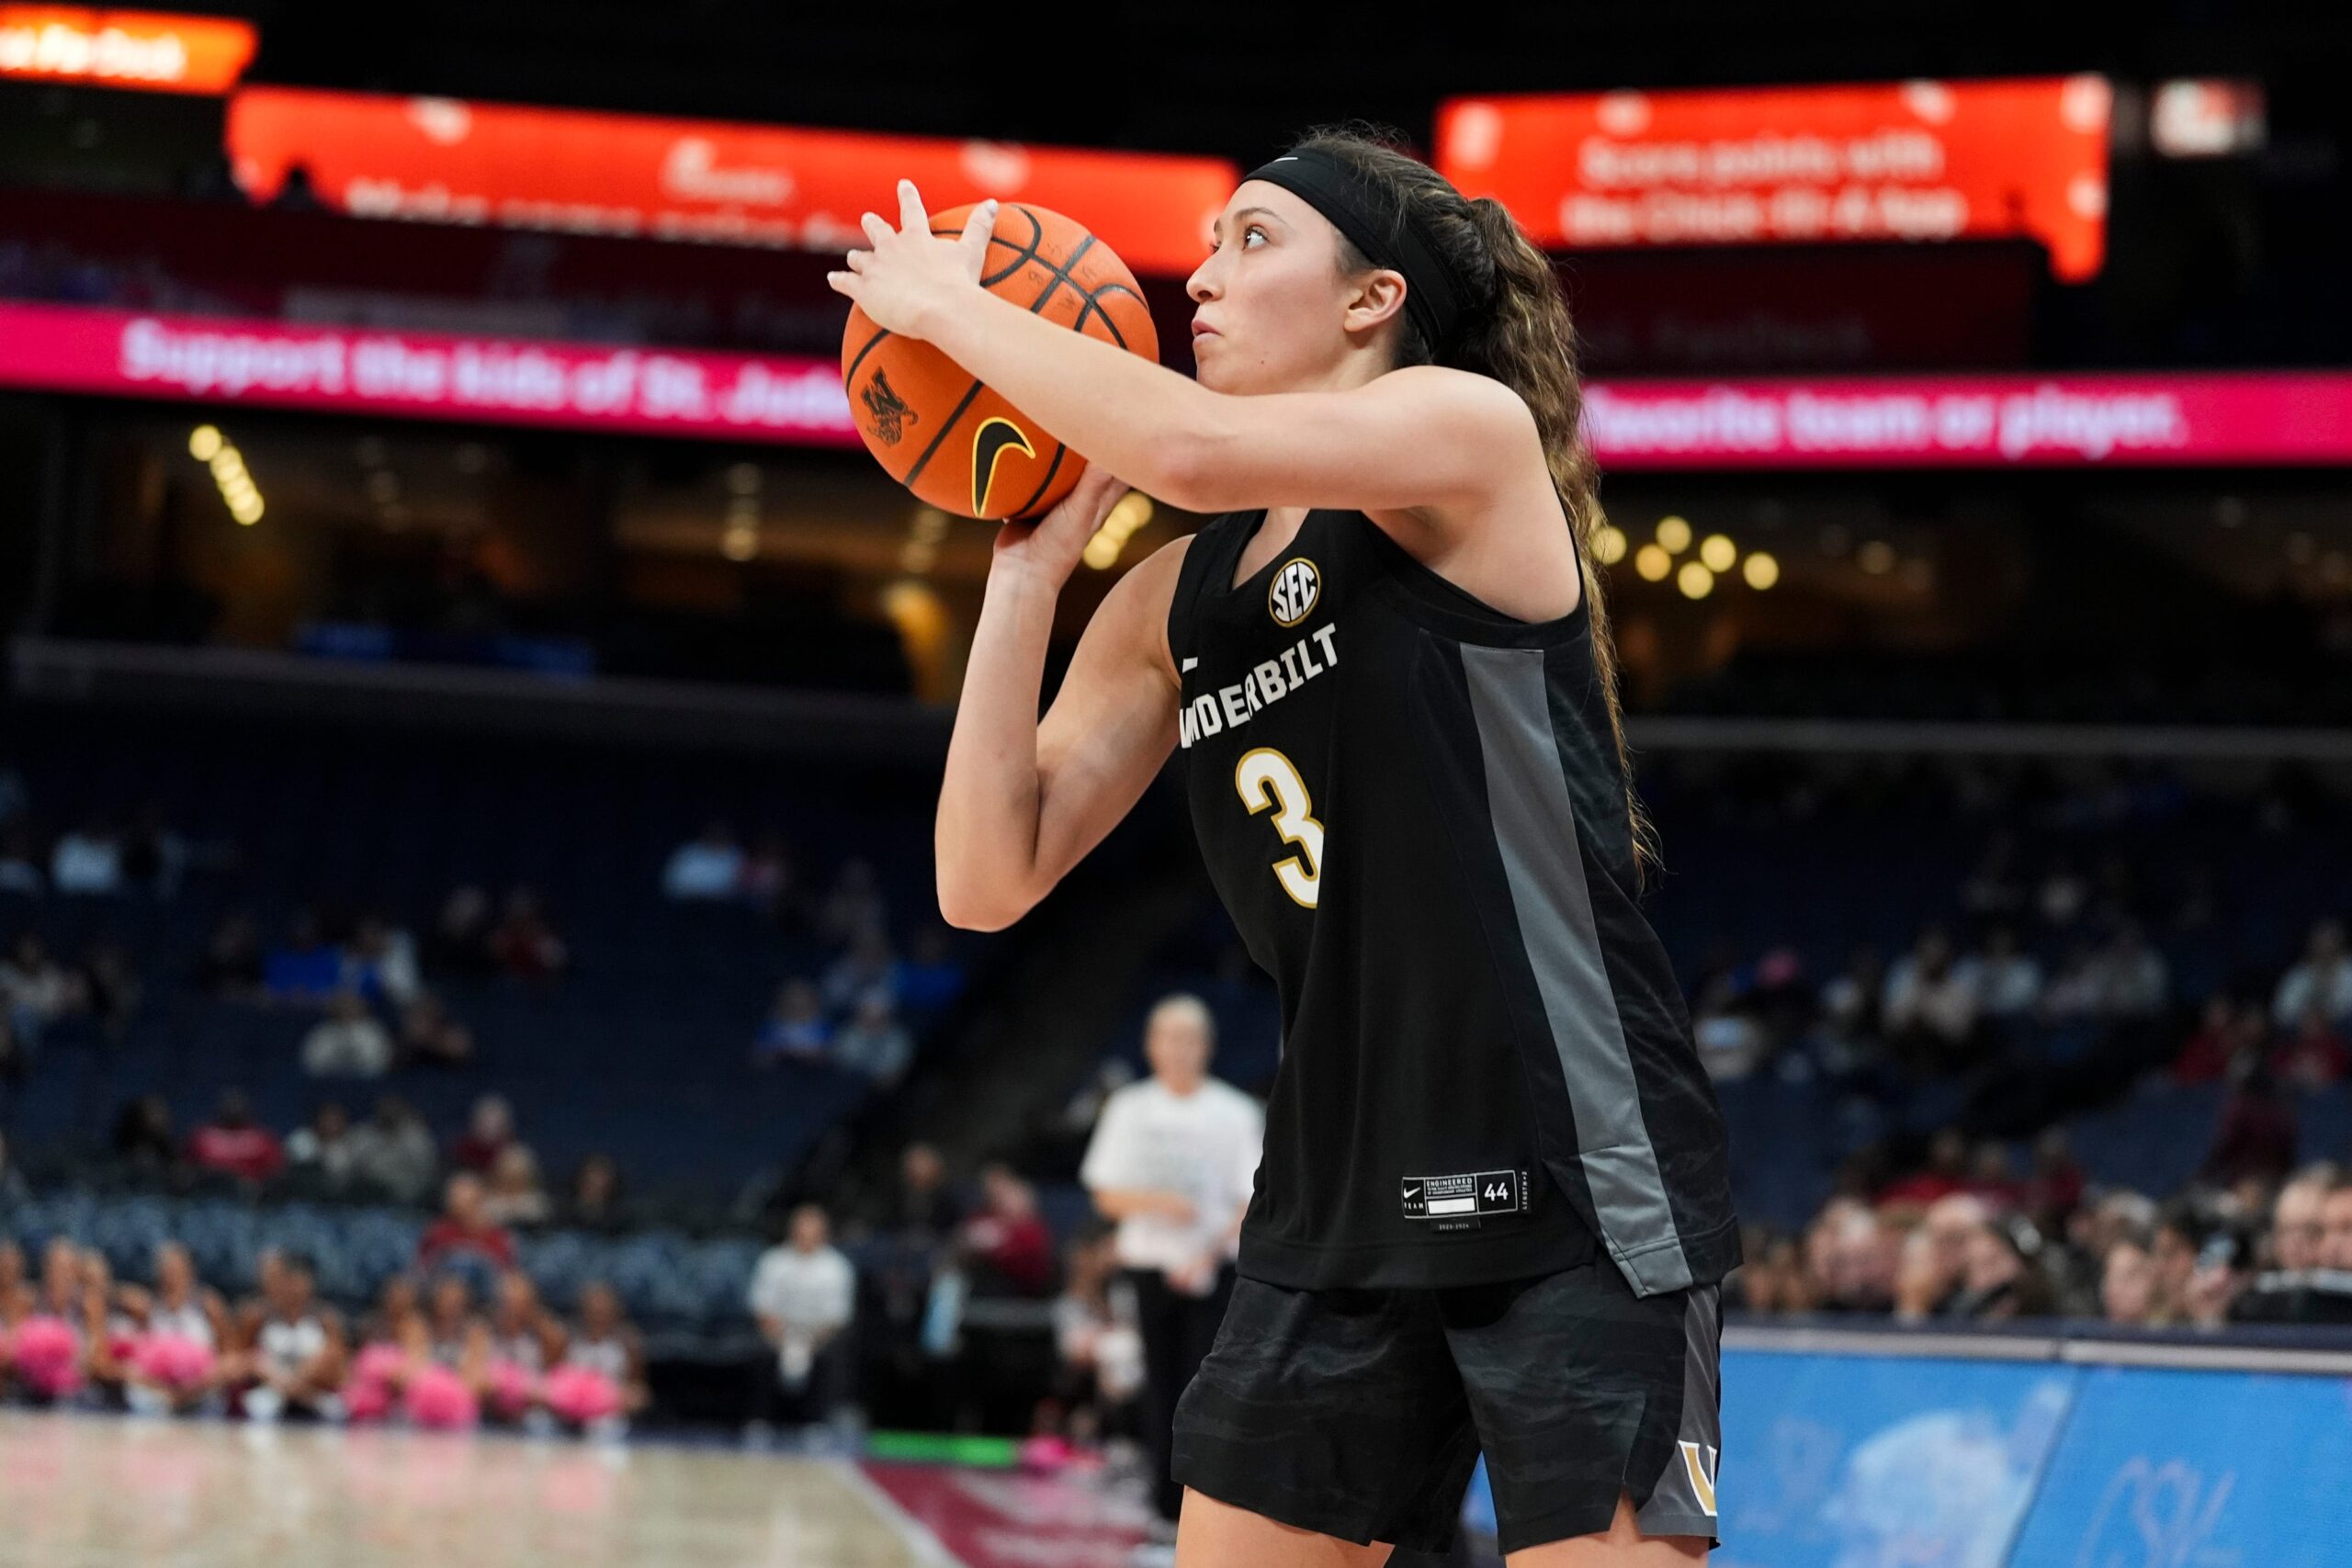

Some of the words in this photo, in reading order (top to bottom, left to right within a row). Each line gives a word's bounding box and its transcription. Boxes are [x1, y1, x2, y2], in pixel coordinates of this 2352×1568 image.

[121, 318, 345, 397] Support
[350, 335, 447, 402] the
[571, 348, 639, 416] of
[719, 363, 854, 431] Jud
[1787, 387, 1928, 452] team
[1933, 393, 1993, 450] or
[1272, 562, 1317, 622] SEC
[1180, 622, 1338, 749] NDERBILT
[1235, 747, 1324, 909] 3
[1403, 1201, 1424, 1210] TEAM
[1426, 1178, 1473, 1187] ENGINEERED
[1484, 1181, 1509, 1201] 44
